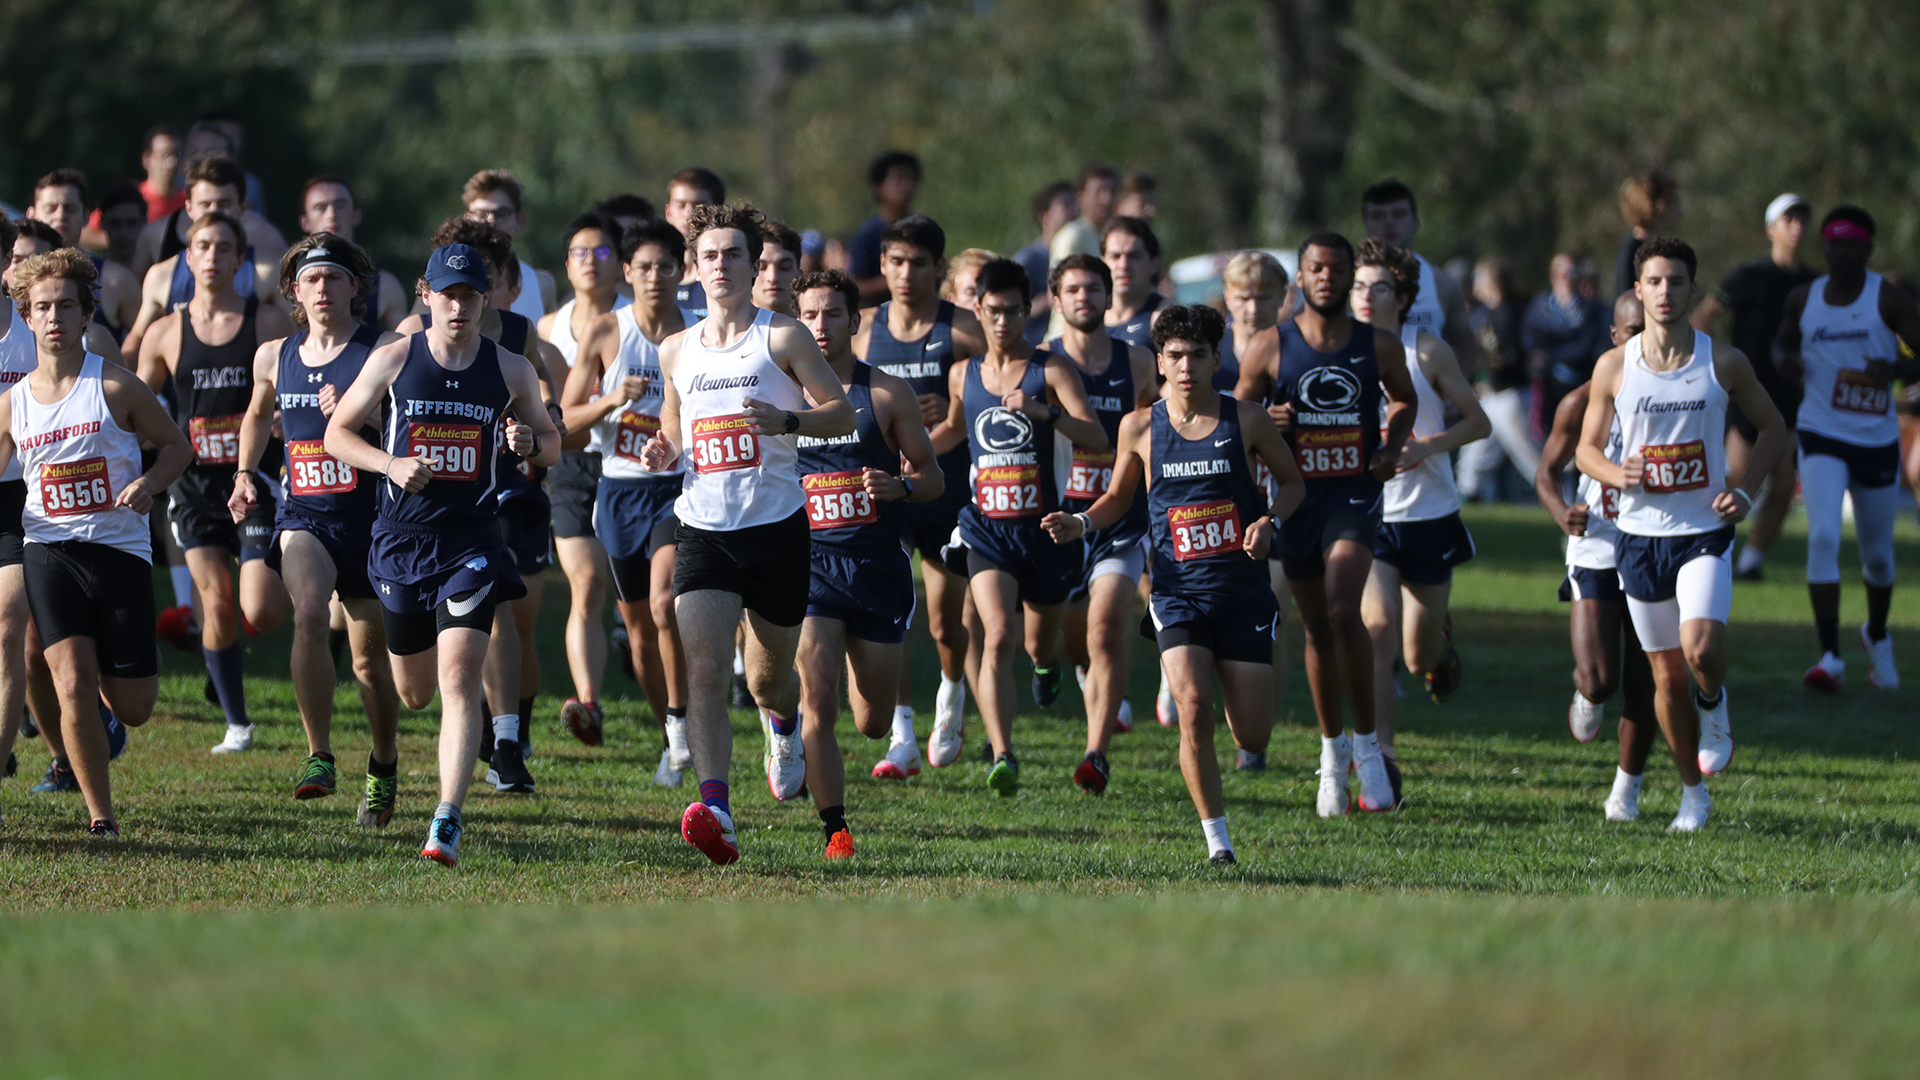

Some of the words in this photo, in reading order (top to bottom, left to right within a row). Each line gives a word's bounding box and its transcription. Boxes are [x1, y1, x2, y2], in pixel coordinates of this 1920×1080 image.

[687, 373, 760, 394] Neumann
[280, 393, 319, 410] JEFFE
[405, 399, 494, 424] JEFFERSON
[1634, 396, 1707, 415] Neumann
[1297, 412, 1361, 426] BRANDYWINE
[19, 421, 101, 451] HAVERFORD
[195, 432, 240, 459] 355
[695, 433, 755, 466] 3619
[978, 451, 1037, 469] BRANDYWINE
[1301, 446, 1360, 472] 3633
[294, 459, 353, 488] 3588
[1066, 466, 1113, 492] 578
[1162, 459, 1231, 478] IMMACULATA
[1645, 458, 1705, 487] 3622
[44, 478, 107, 510] 3556
[809, 490, 871, 521] 3583
[981, 484, 1039, 511] 3632
[1175, 518, 1237, 553] 3584
